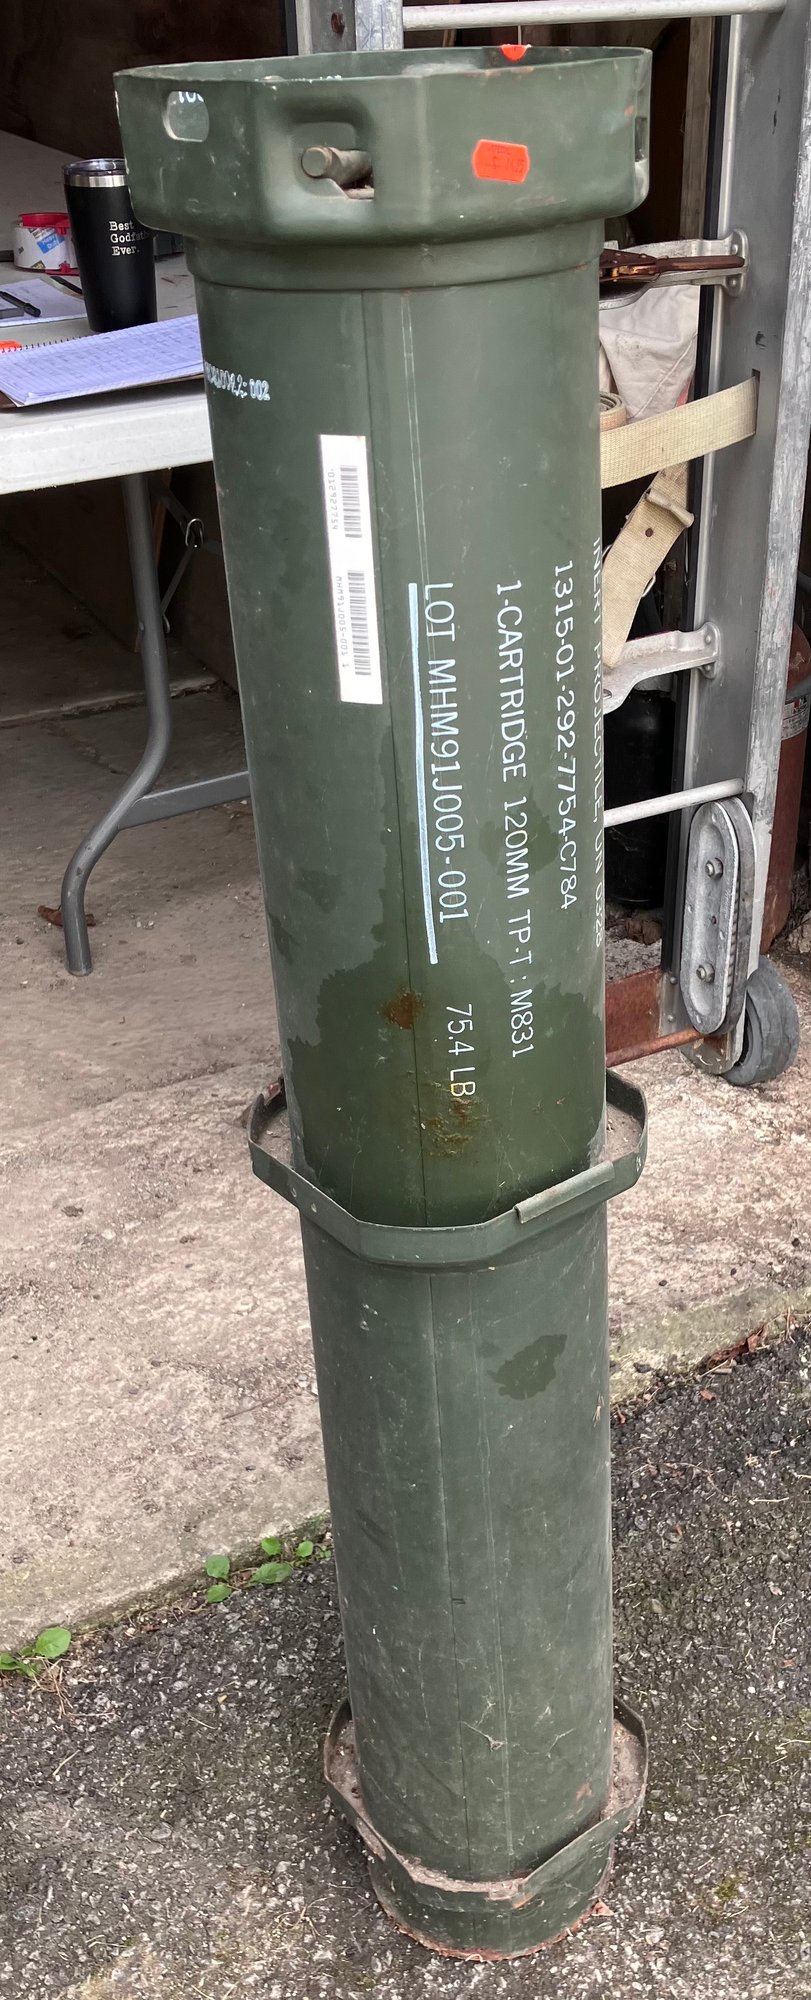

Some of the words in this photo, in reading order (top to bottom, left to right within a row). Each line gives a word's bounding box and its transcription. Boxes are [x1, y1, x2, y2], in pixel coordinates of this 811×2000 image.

[109, 220, 134, 231] Best
[112, 246, 140, 256] Ever.
[593, 538, 602, 625] INERT
[424, 583, 456, 641] LOT
[496, 580, 527, 782] 1-CARTRIDGE
[553, 560, 577, 910] 1315-01-292-7754-C784
[428, 659, 469, 925] MHM91J005-001
[504, 796, 529, 899] 120MM
[594, 830, 602, 873] UN
[508, 909, 532, 965] TP-T
[446, 1003, 475, 1055] 75.4
[510, 989, 534, 1057] M831
[448, 1067, 476, 1096] LB
